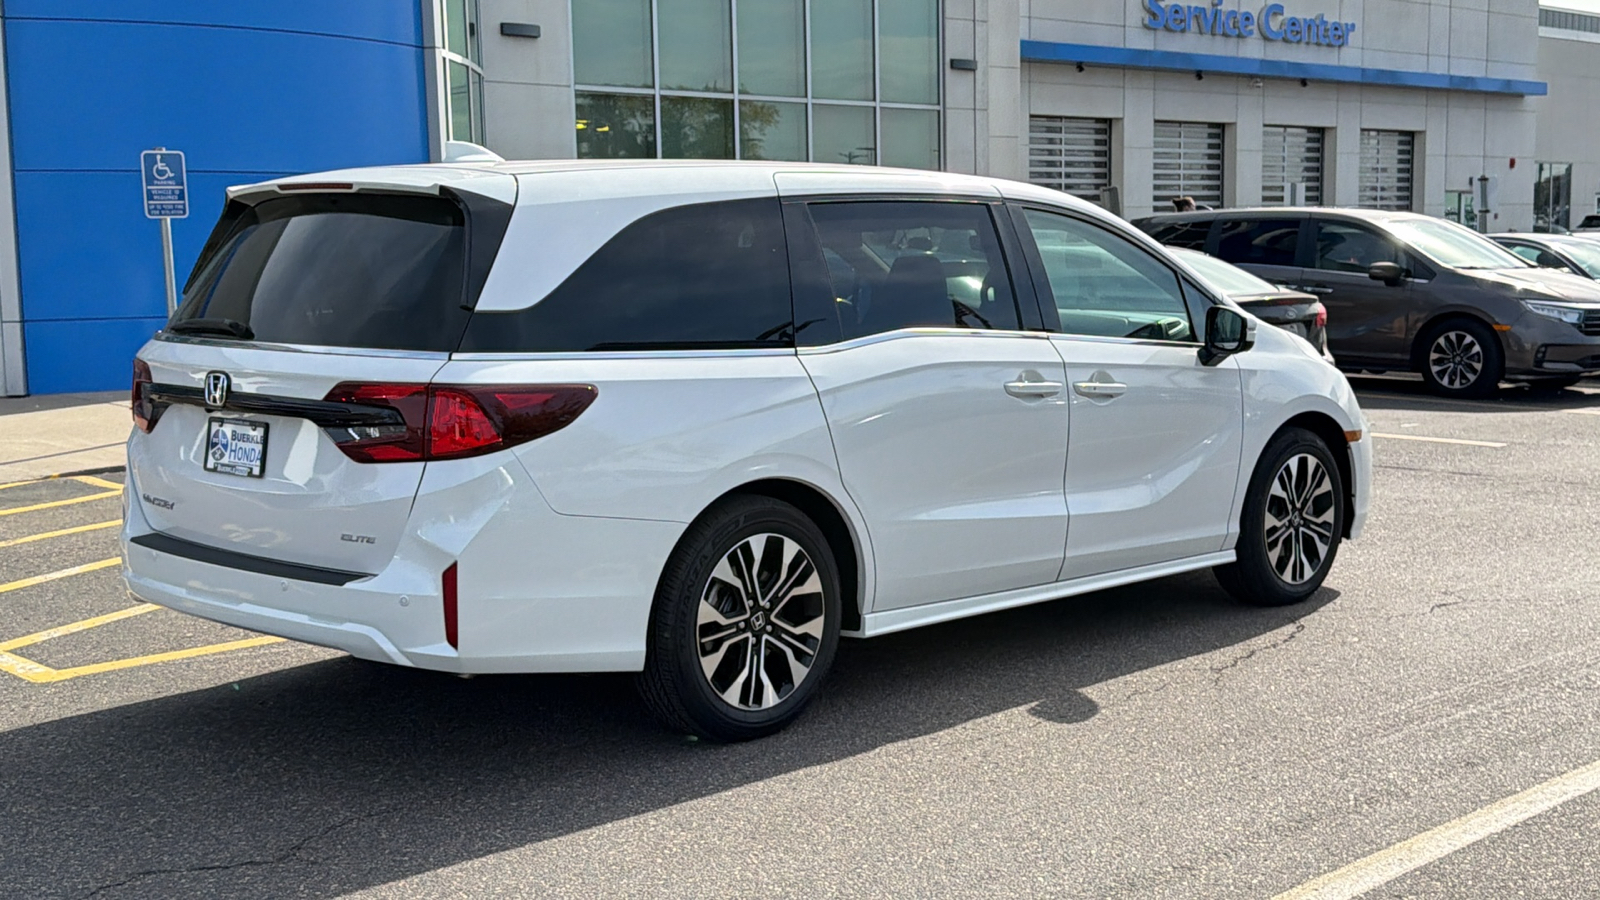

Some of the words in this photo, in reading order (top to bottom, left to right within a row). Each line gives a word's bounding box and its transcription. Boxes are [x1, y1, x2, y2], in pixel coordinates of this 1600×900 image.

[1142, 0, 1254, 36] Service
[1258, 4, 1356, 46] Center
[231, 429, 264, 444] BUERKLE
[228, 442, 262, 463] HONDA
[340, 533, 376, 544] ELITE
